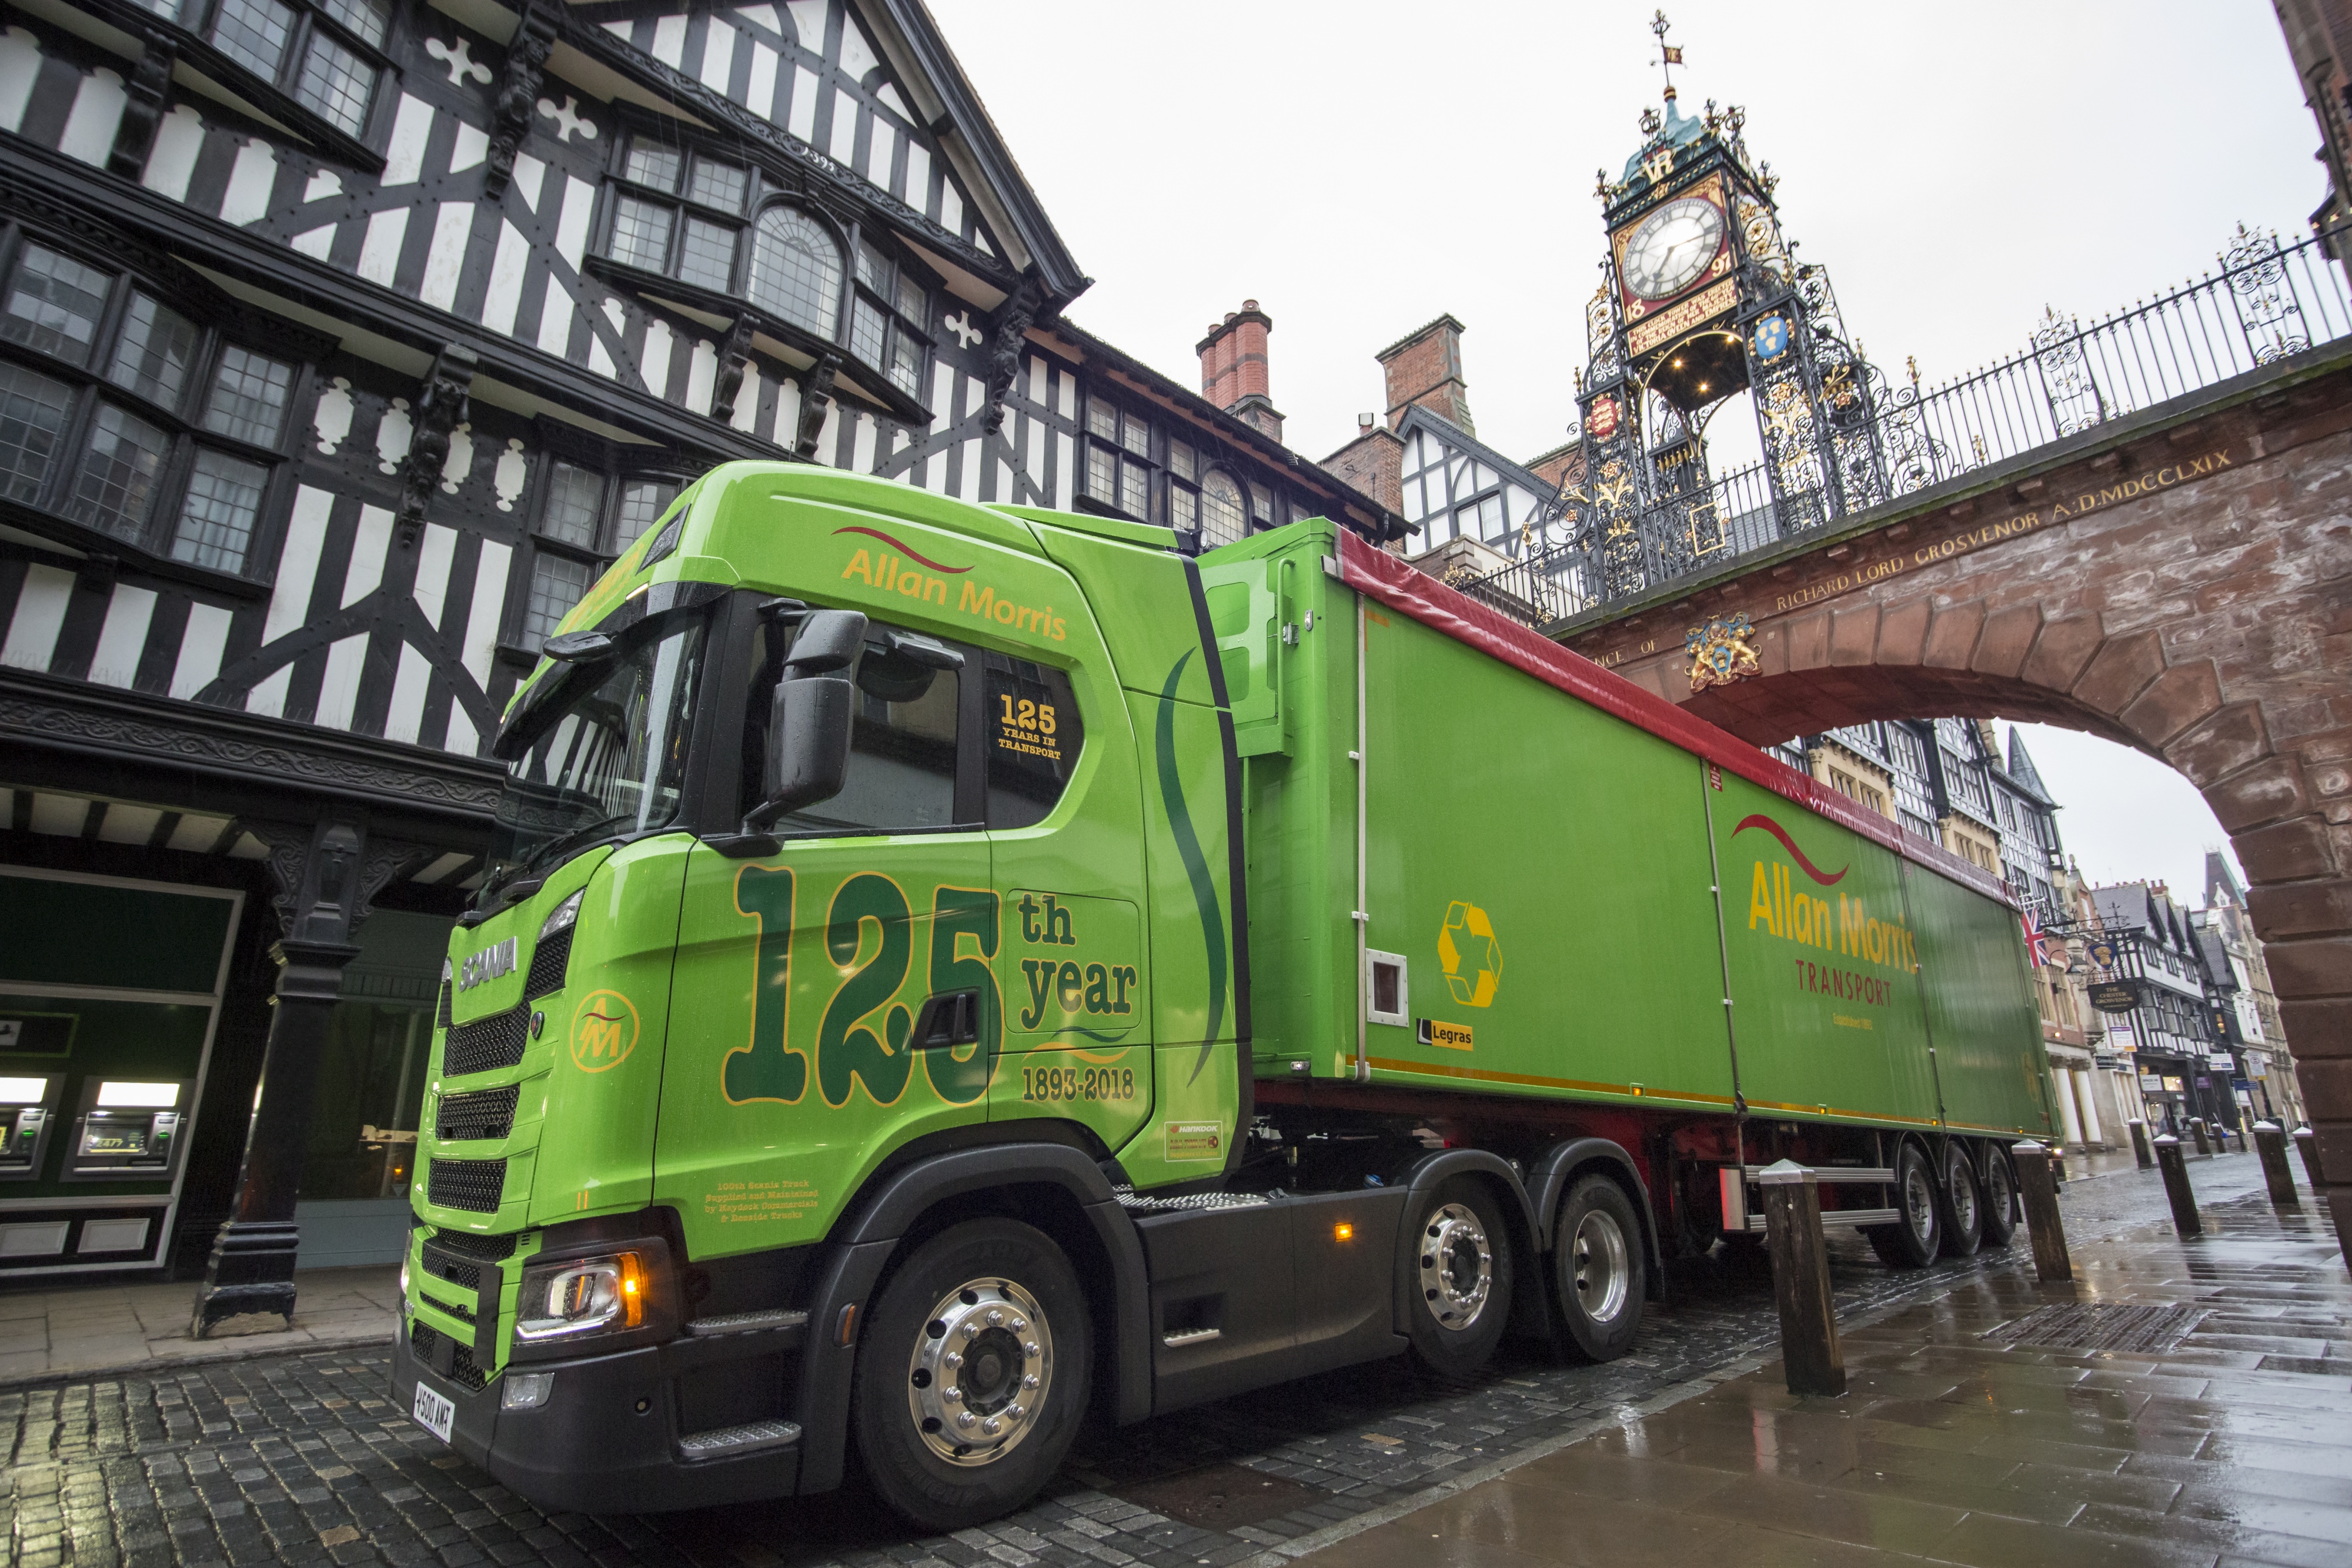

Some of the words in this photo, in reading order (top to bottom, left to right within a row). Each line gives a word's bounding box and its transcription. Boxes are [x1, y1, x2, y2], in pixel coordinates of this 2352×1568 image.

[1711, 250, 1732, 277] 97
[1625, 298, 1645, 322] 18
[1631, 334, 1638, 343] IN
[1638, 307, 1689, 339] COMMEMORATION
[1699, 298, 1709, 307] THE
[1632, 323, 1646, 336] THIS
[1648, 313, 1665, 327] CLOCK
[1668, 301, 1689, 317] TOWER
[1690, 294, 1705, 305] WAS
[1645, 332, 1656, 342] THE
[1658, 323, 1676, 336] REIGN
[1687, 309, 1700, 320] HER
[1702, 292, 1733, 312] MAJESTY
[1633, 332, 1667, 353] VICTORIA
[1691, 313, 1705, 324] AND
[1777, 574, 1849, 610] RICHARD
[1856, 557, 1904, 584] LORD
[1915, 512, 2040, 564] GROSVENOR
[841, 549, 947, 606] Allan
[958, 580, 1067, 641] Morris
[1000, 694, 1056, 734] 125
[999, 738, 1061, 760] TRANSPORT
[1003, 727, 1040, 743] YEARS
[1043, 736, 1055, 747] IN
[1749, 861, 1832, 951] Allan
[1840, 892, 1918, 974] Morris
[459, 936, 518, 992] SCANIA
[1796, 959, 1890, 1008] TRANSPORT
[720, 862, 1004, 1109] 125
[1018, 893, 1076, 945] th
[1021, 958, 1137, 1031] year
[1433, 1025, 1472, 1044] Legras
[1021, 1067, 1135, 1102] 1893-2018
[706, 1193, 747, 1203] Supplied
[749, 1192, 765, 1200] and
[767, 1190, 818, 1199] Maintained
[718, 1183, 746, 1191] 100th
[748, 1181, 780, 1189] Scania
[782, 1179, 809, 1188] Truck
[705, 1206, 716, 1214] by
[719, 1203, 759, 1213] Haydock
[761, 1200, 818, 1210] Commercials
[731, 1213, 768, 1222] Deeside
[770, 1211, 803, 1219] Trucks
[434, 1400, 450, 1434] AMT
